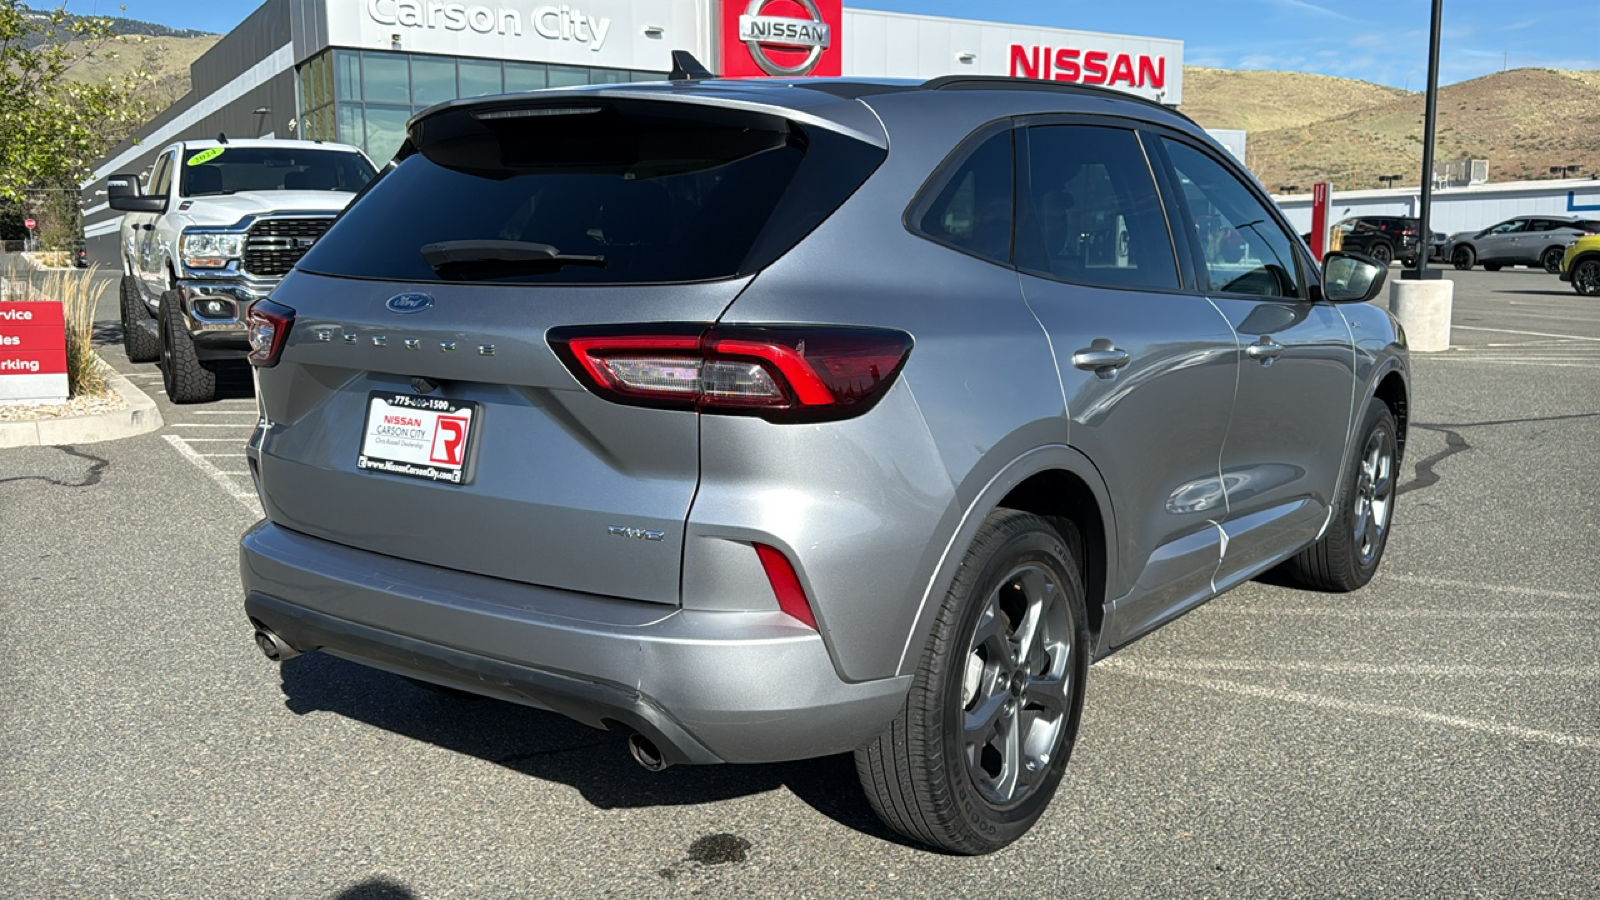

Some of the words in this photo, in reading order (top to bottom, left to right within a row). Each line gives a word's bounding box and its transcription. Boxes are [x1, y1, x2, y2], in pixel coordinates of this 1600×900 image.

[368, 0, 522, 37] Carson
[534, 4, 611, 51] City
[751, 21, 823, 41] NISSAN
[1010, 44, 1165, 88] NISSAN
[384, 415, 422, 427] NISSAN
[376, 425, 409, 437] CARSON
[410, 428, 427, 440] CITY
